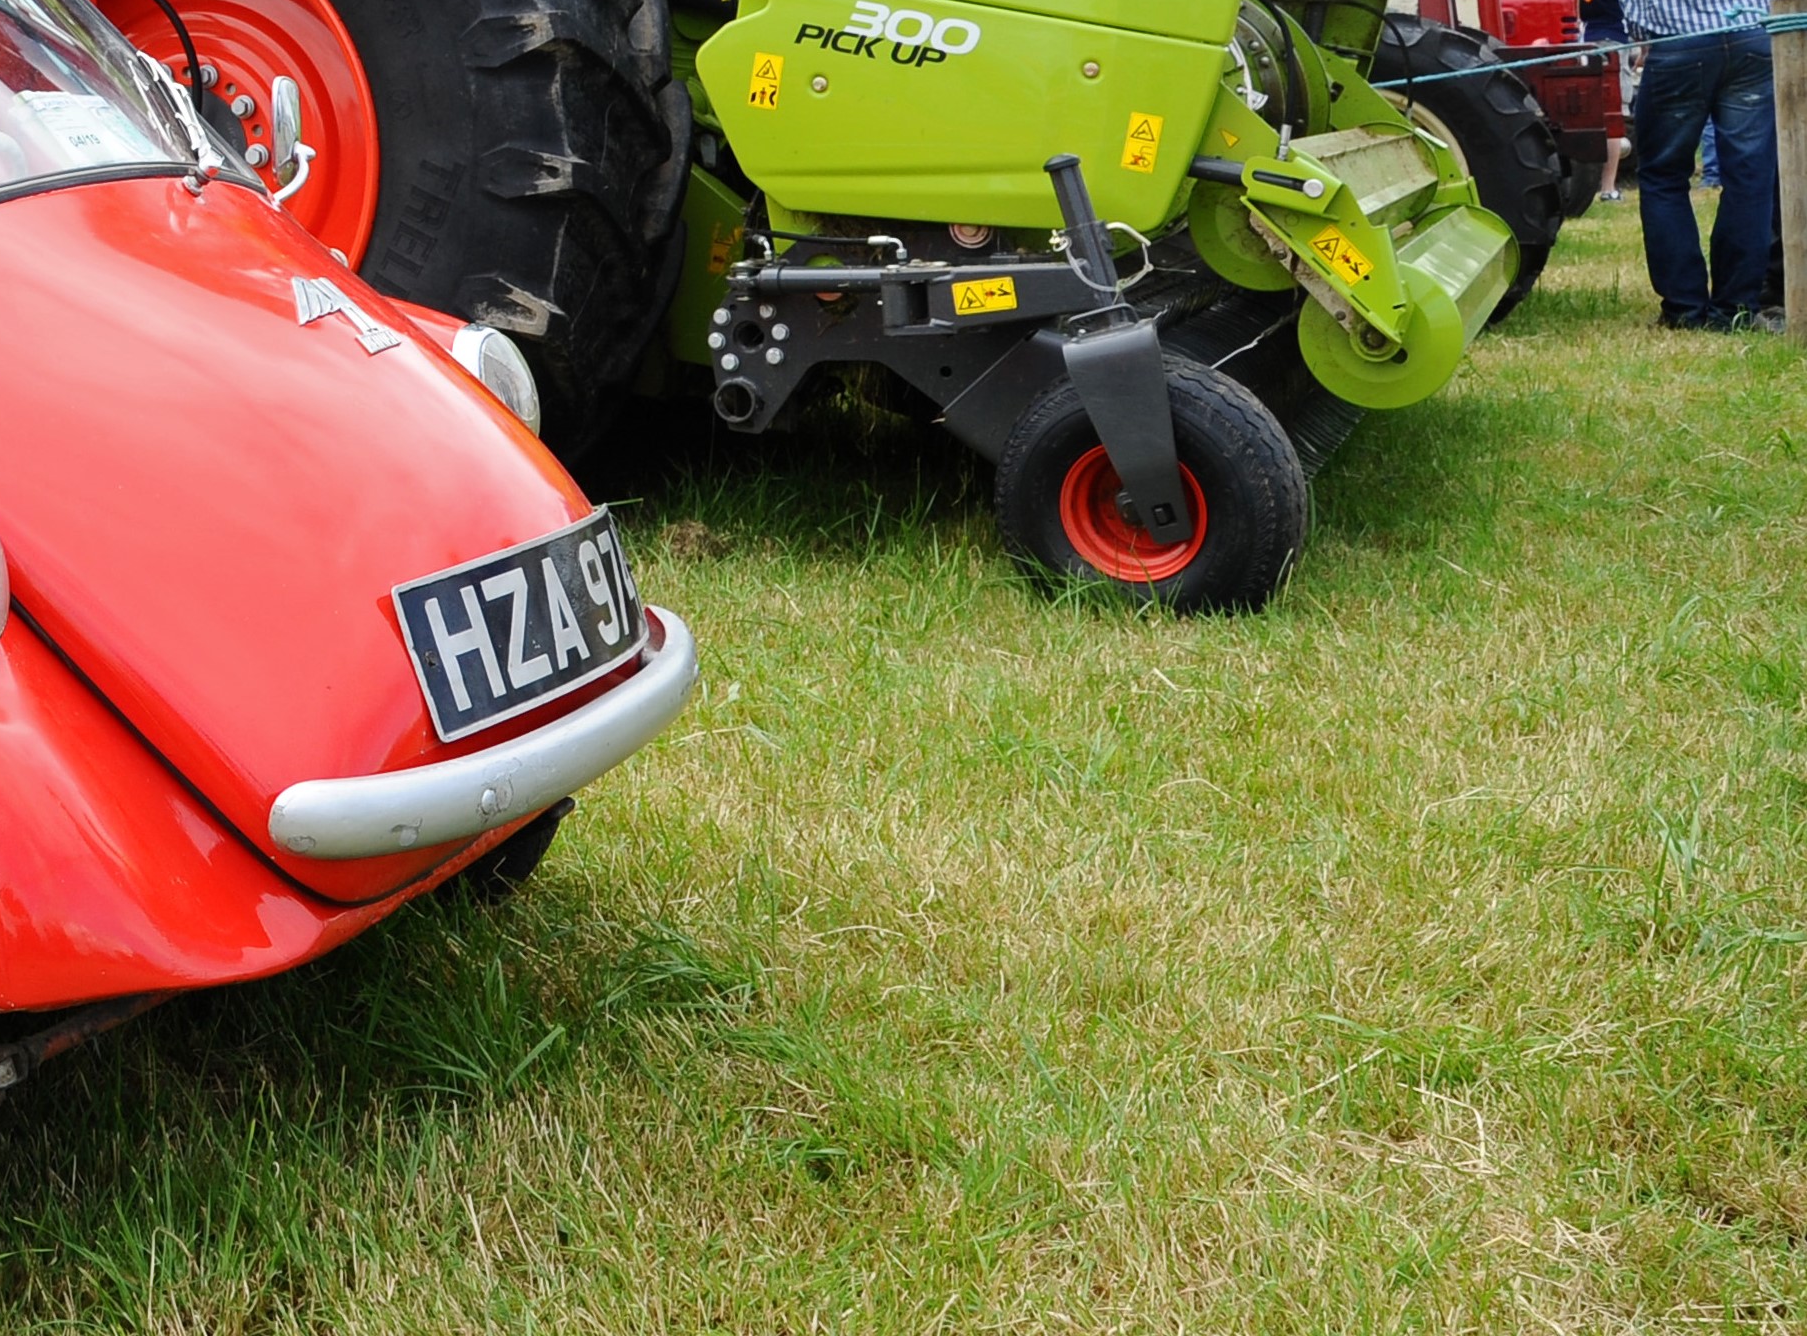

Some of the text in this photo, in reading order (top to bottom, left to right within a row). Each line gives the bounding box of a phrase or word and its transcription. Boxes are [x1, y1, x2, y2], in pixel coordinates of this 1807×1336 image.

[794, 23, 948, 68] PICK UP
[843, 0, 982, 55] 300
[68, 133, 102, 148] 04/19
[424, 556, 591, 713] HZA
